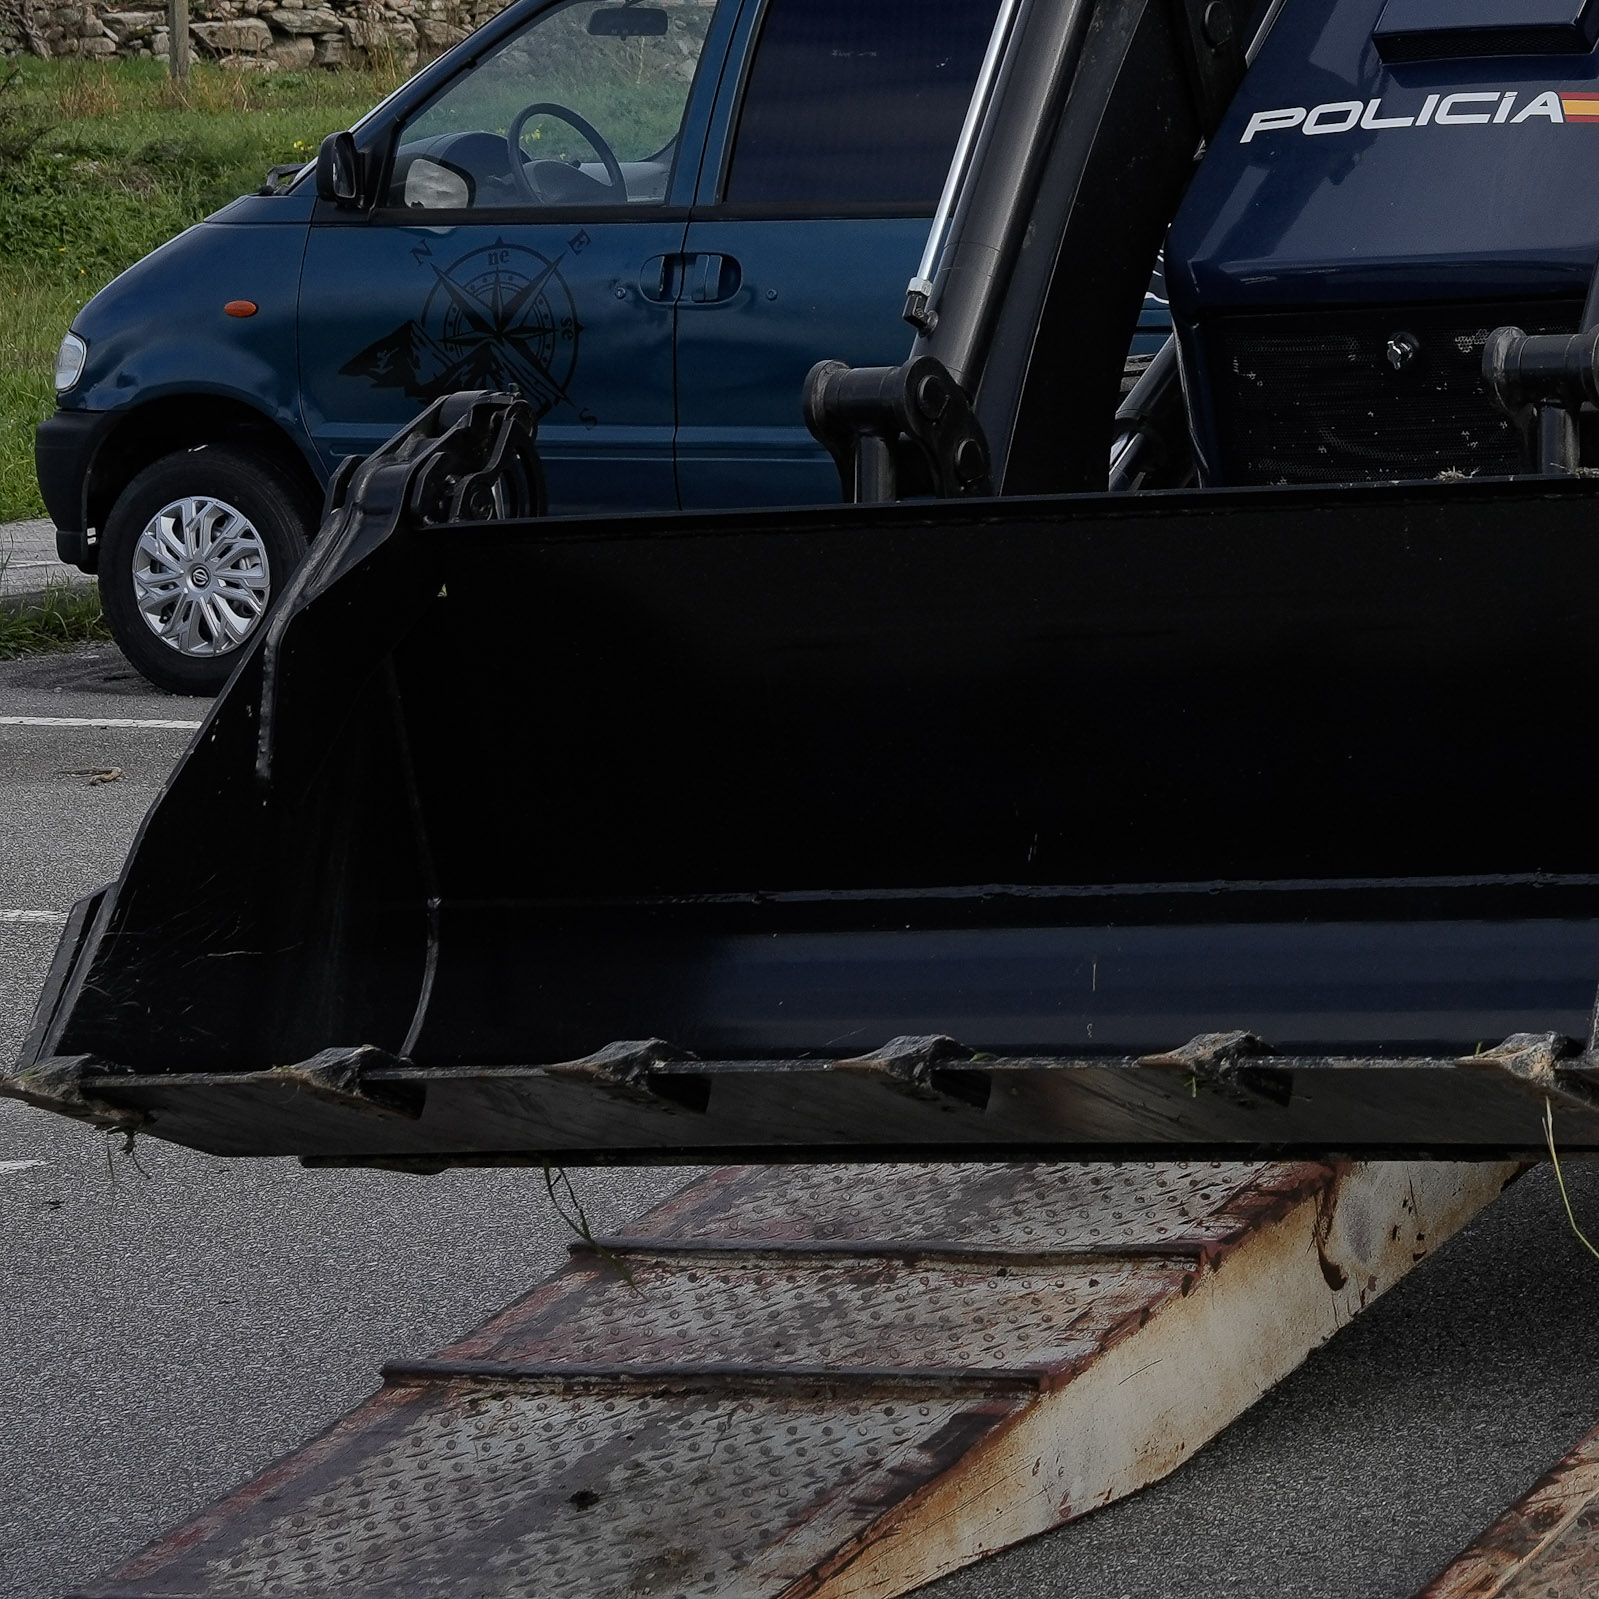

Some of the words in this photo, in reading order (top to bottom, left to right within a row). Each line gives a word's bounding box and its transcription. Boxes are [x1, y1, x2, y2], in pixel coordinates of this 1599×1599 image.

[409, 239, 433, 266] N
[568, 229, 592, 255] E
[487, 250, 510, 266] ne
[560, 317, 575, 341] se
